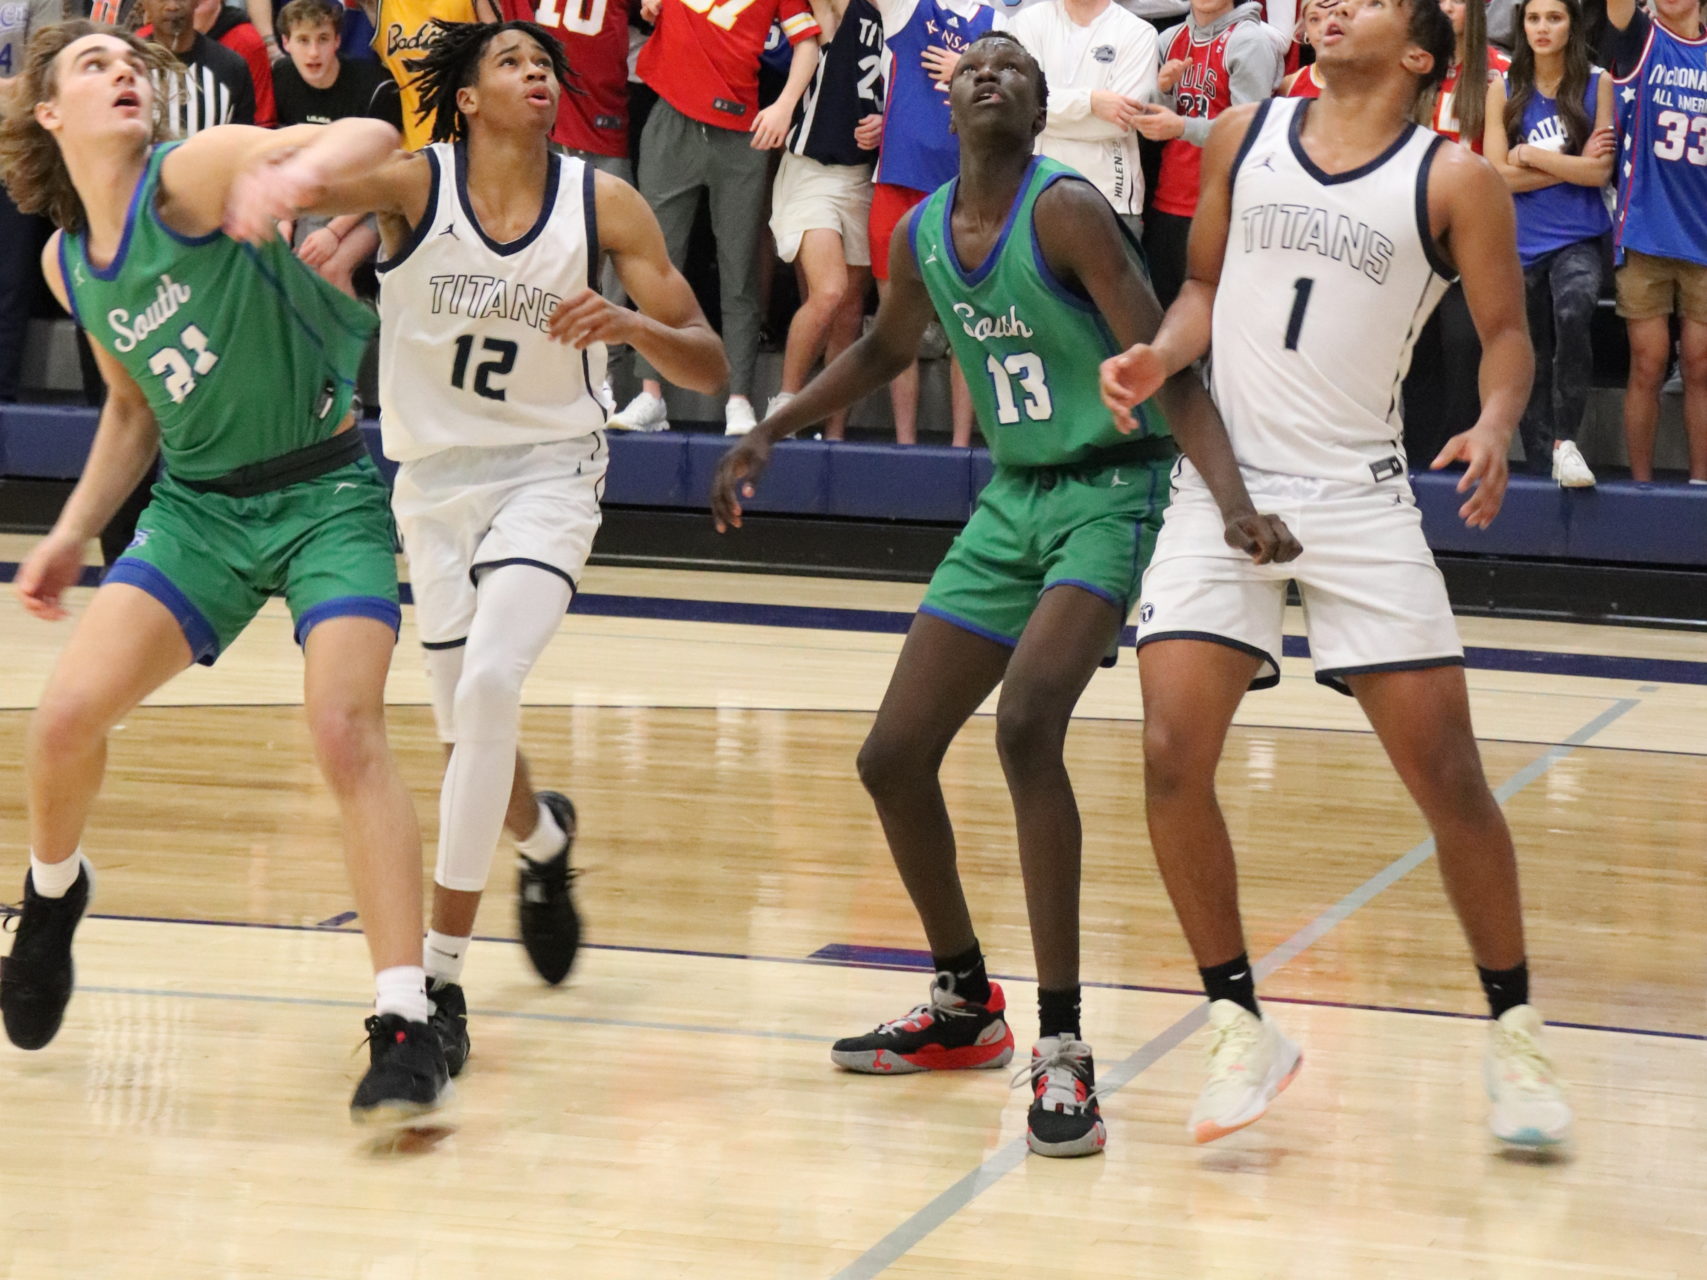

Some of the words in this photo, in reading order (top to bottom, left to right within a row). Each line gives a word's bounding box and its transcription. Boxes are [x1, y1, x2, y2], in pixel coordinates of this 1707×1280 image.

[926, 20, 970, 53] KNSA
[1653, 87, 1674, 107] ALL
[1653, 110, 1707, 167] 33
[1241, 204, 1395, 285] TITANS
[108, 274, 191, 352] South
[429, 274, 563, 333] TITANS
[1285, 277, 1315, 352] 1
[451, 334, 518, 401] 12
[986, 352, 1053, 424] 13
